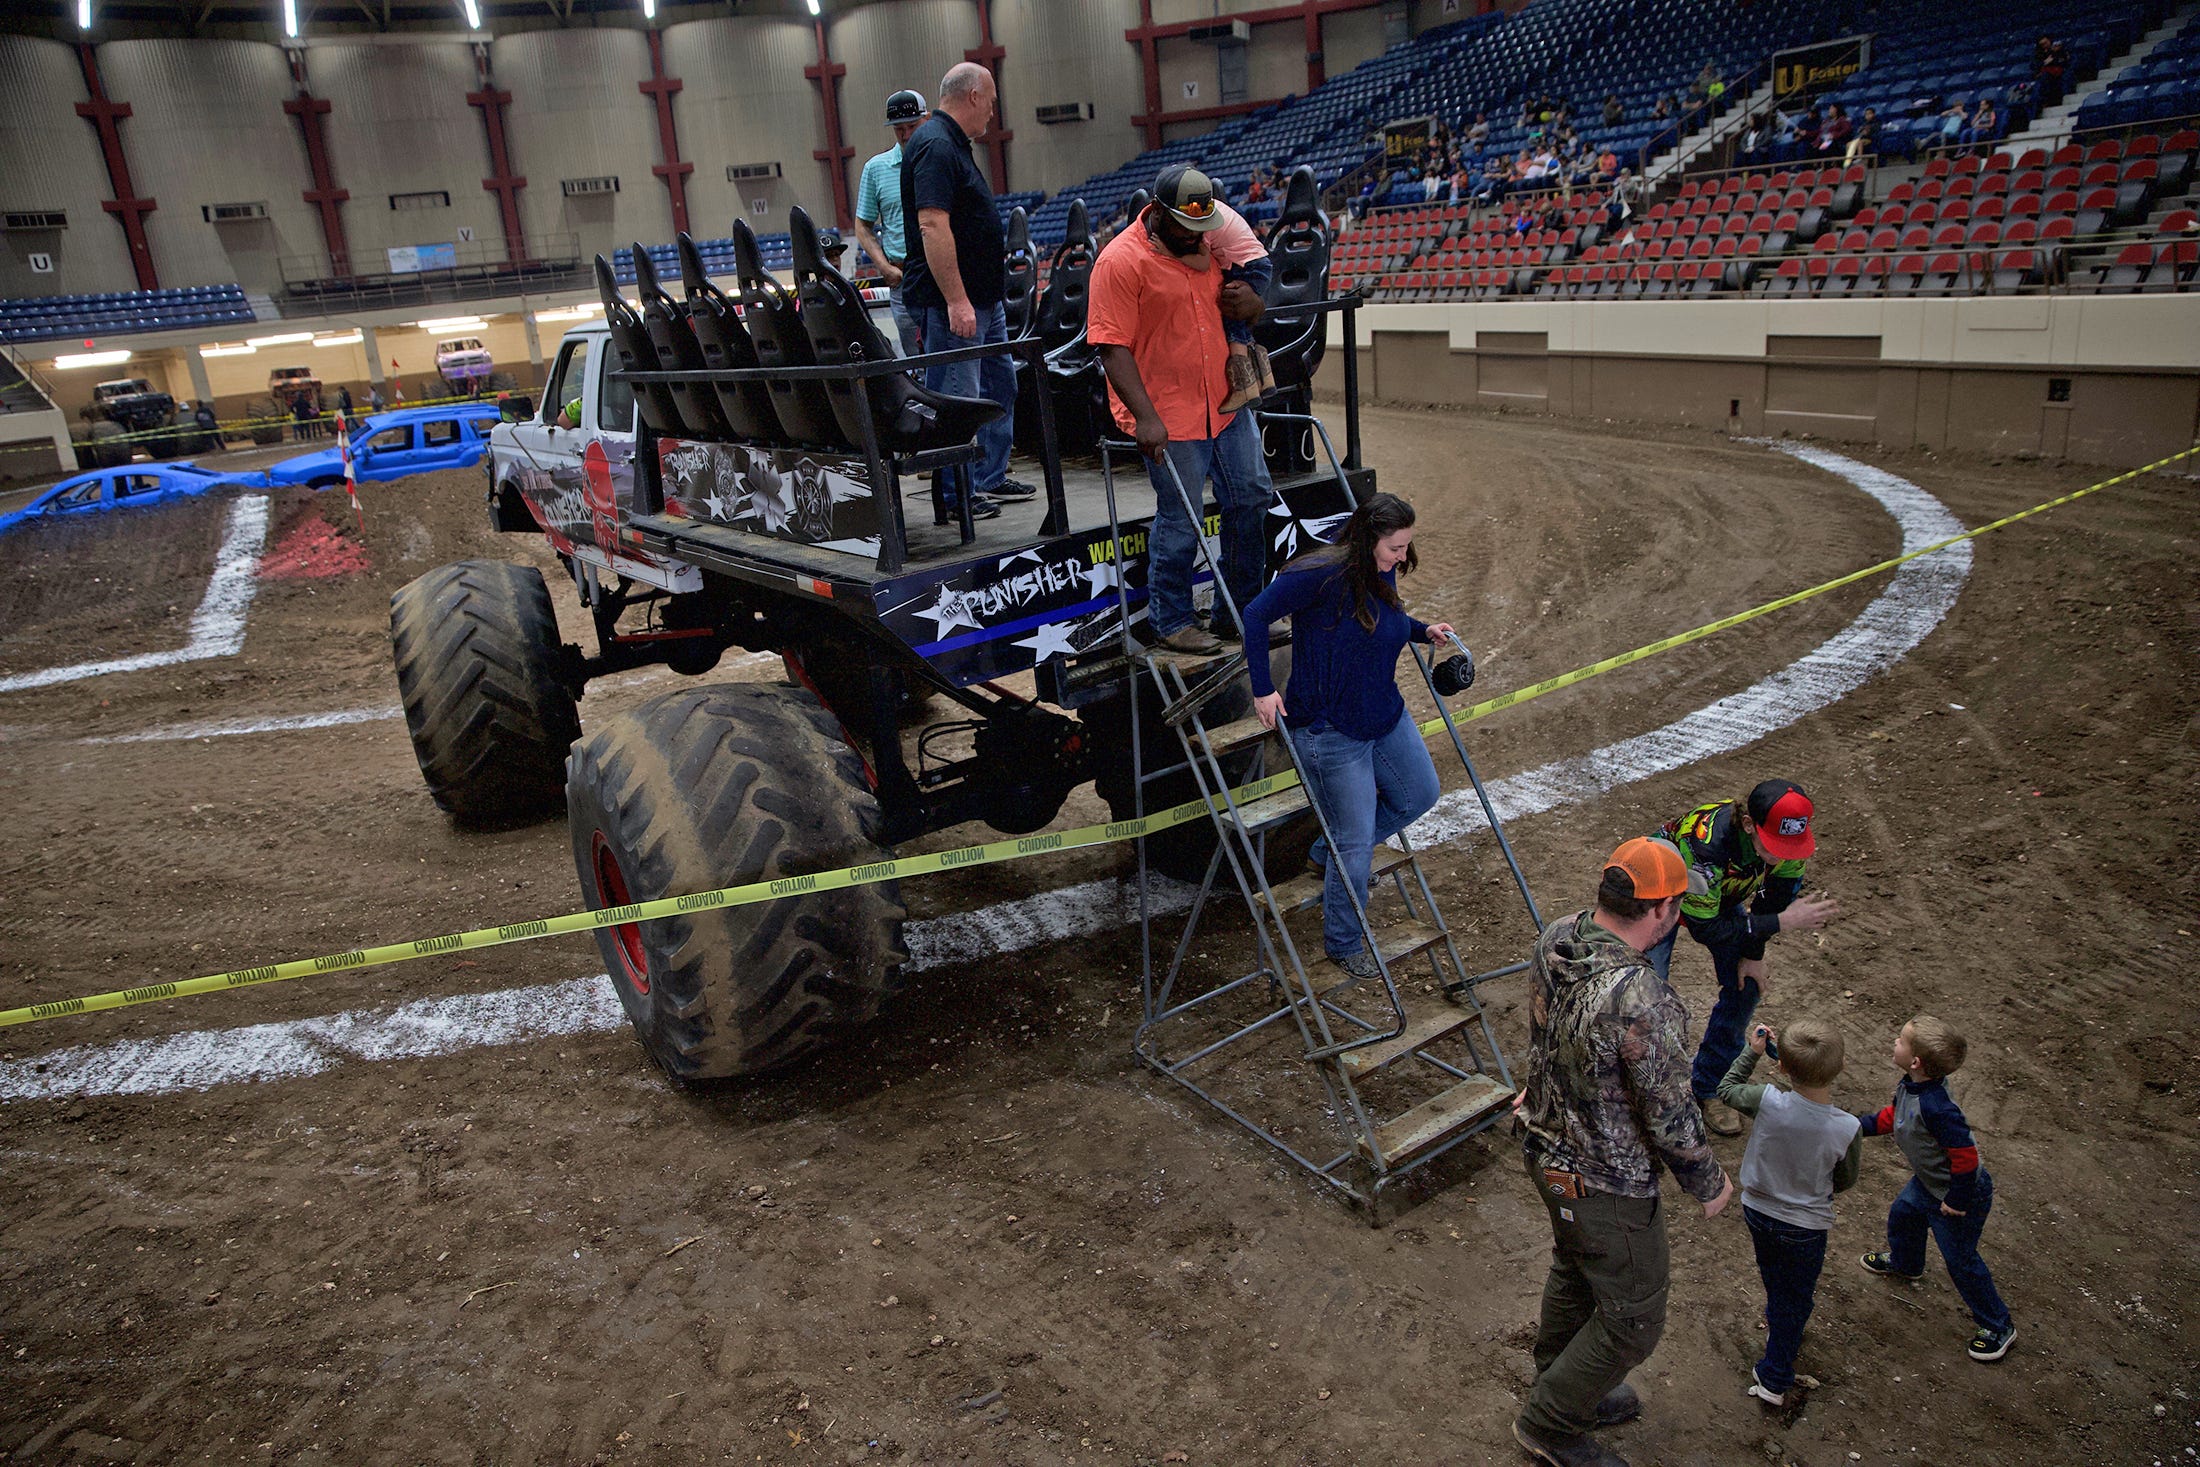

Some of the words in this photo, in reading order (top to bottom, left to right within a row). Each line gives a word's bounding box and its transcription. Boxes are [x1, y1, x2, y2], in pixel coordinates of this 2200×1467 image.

[1445, 0, 1457, 10] A
[1776, 64, 1804, 94] U
[1186, 84, 1196, 96] Y
[753, 200, 766, 213] W
[460, 229, 470, 241] V
[33, 256, 49, 270] U
[941, 599, 963, 619] THE
[960, 557, 1090, 624] PUNISHER
